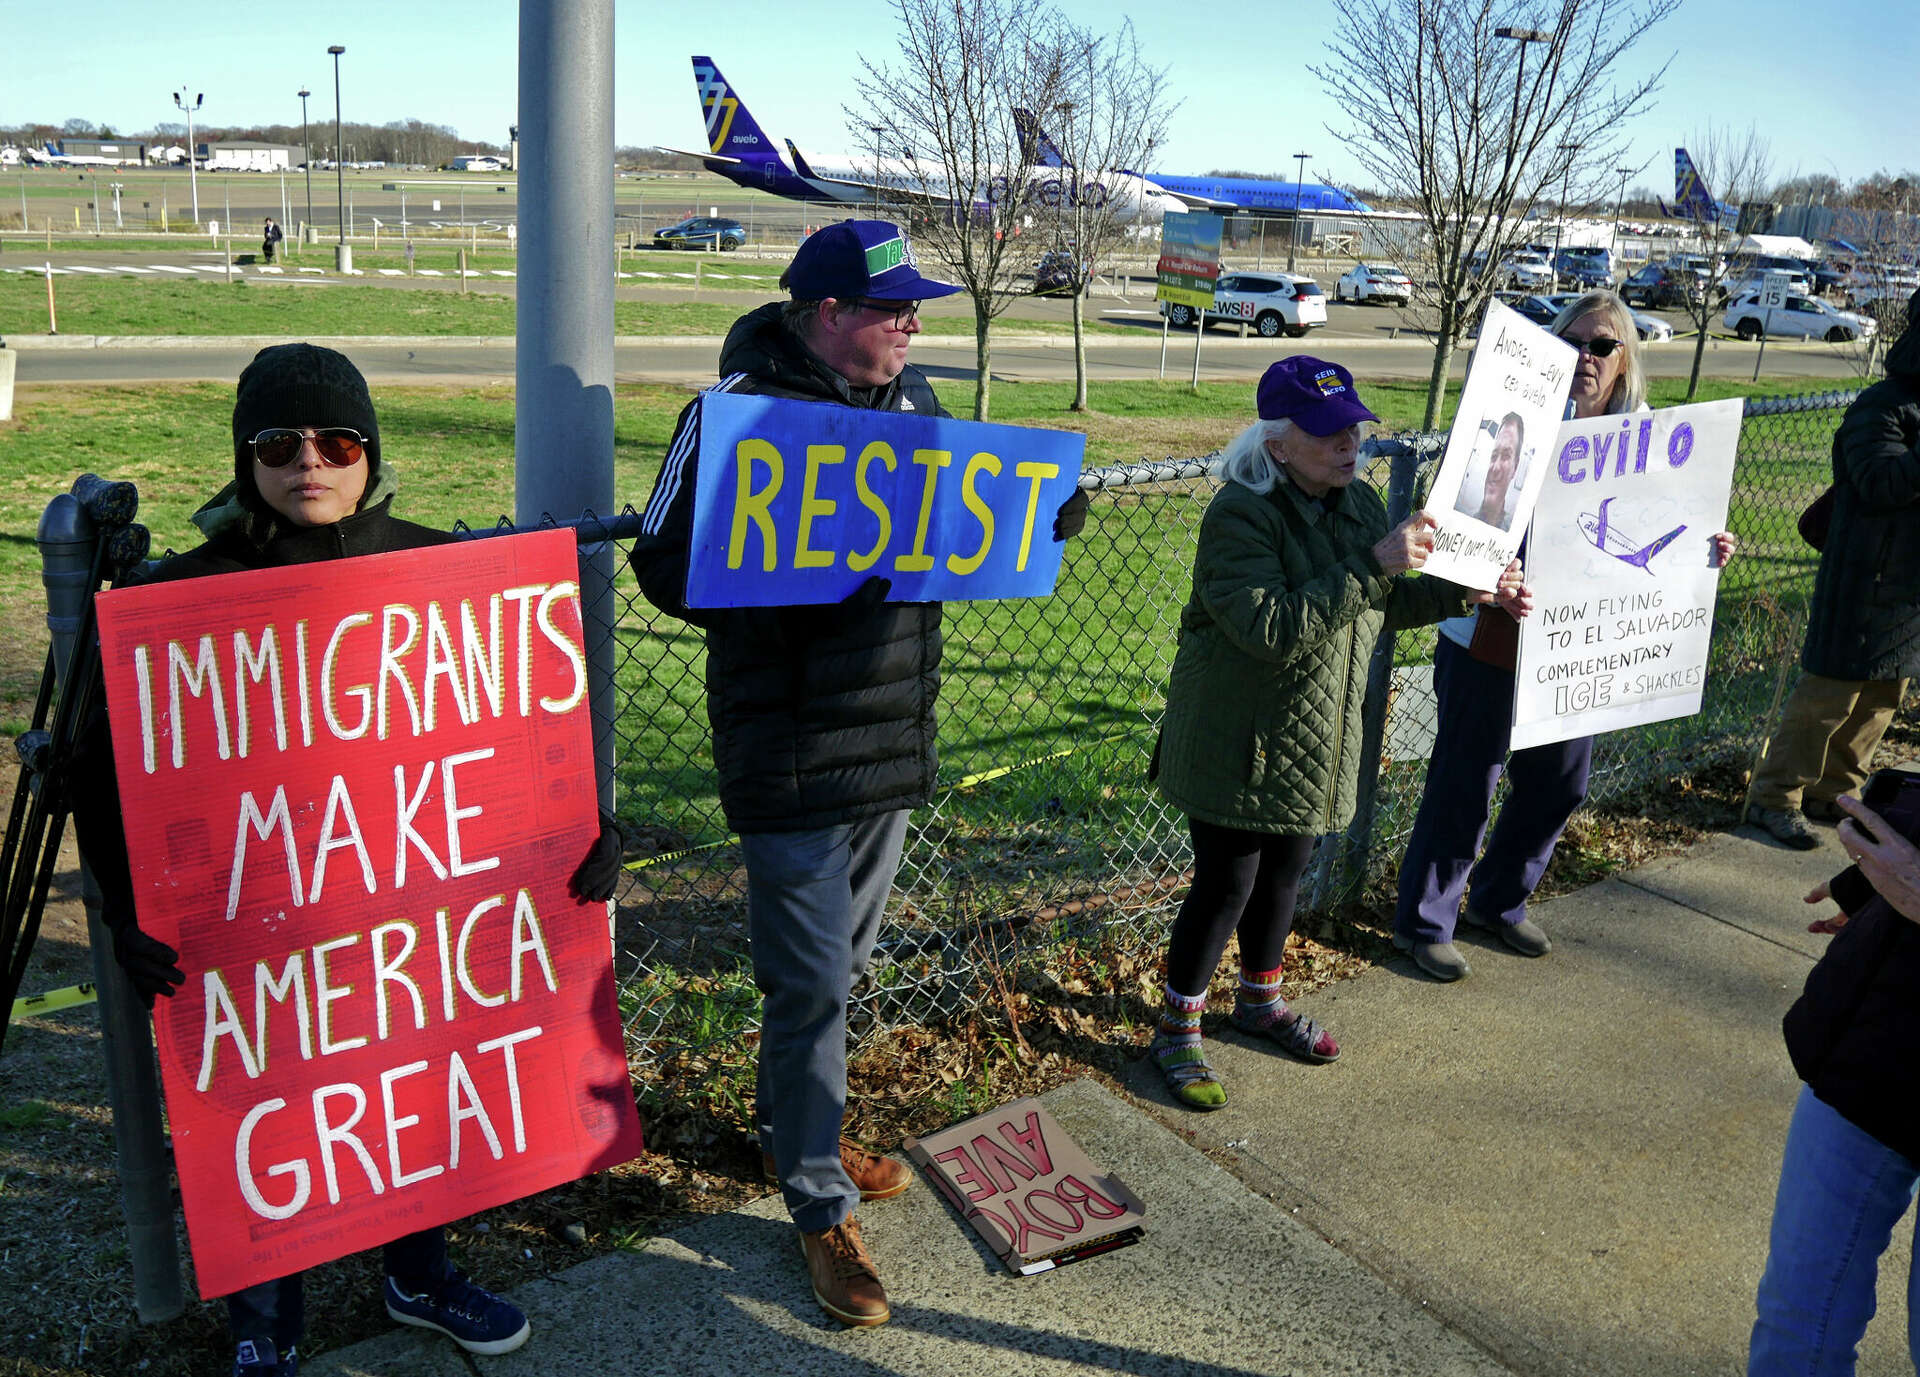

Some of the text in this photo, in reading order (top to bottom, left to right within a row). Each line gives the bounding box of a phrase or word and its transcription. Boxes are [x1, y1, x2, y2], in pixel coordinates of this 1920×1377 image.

[733, 134, 759, 145] avelo
[1766, 292, 1780, 305] 15
[1314, 369, 1336, 381] SEIU
[1558, 418, 1694, 484] evil o
[727, 438, 1059, 575] RESIST
[1543, 590, 1663, 626] NOW FLYING
[1547, 607, 1708, 652] TO EL SALVADOR
[135, 581, 588, 774] IMMIGRANTS
[1536, 643, 1674, 684] COMPLEMENTARY
[1555, 665, 1702, 715] ICE & SHACKLES
[226, 748, 500, 921] MAKE
[196, 888, 560, 1093] AMERICA
[235, 1026, 543, 1220] GREAT
